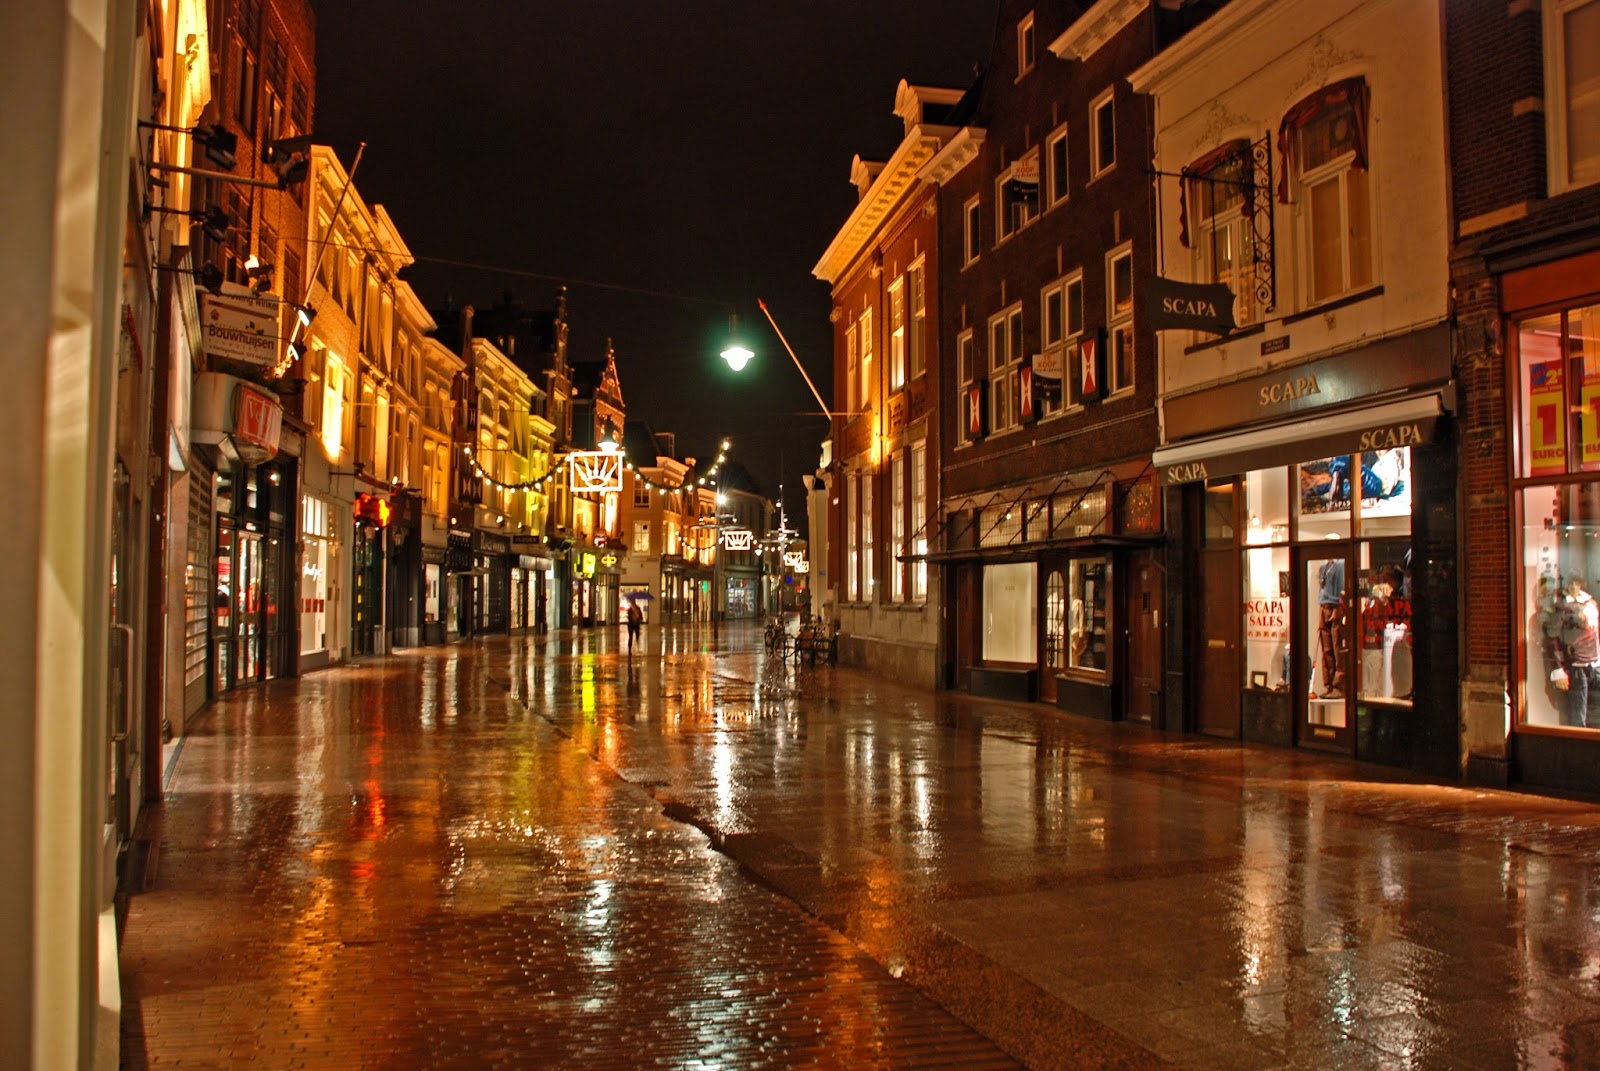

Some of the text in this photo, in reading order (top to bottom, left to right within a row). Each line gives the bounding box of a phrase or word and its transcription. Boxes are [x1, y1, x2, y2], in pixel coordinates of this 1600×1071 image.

[1163, 297, 1216, 318] SCAPA
[209, 324, 274, 349] Bouwhuijsen
[1037, 360, 1057, 368] KOOP
[1259, 374, 1321, 406] SCAPA
[1359, 423, 1423, 451] SCAPA
[1533, 448, 1564, 459] EURO
[1167, 462, 1208, 484] SCAPA
[1247, 600, 1284, 614] SCAPA
[1249, 616, 1283, 627] SALES
